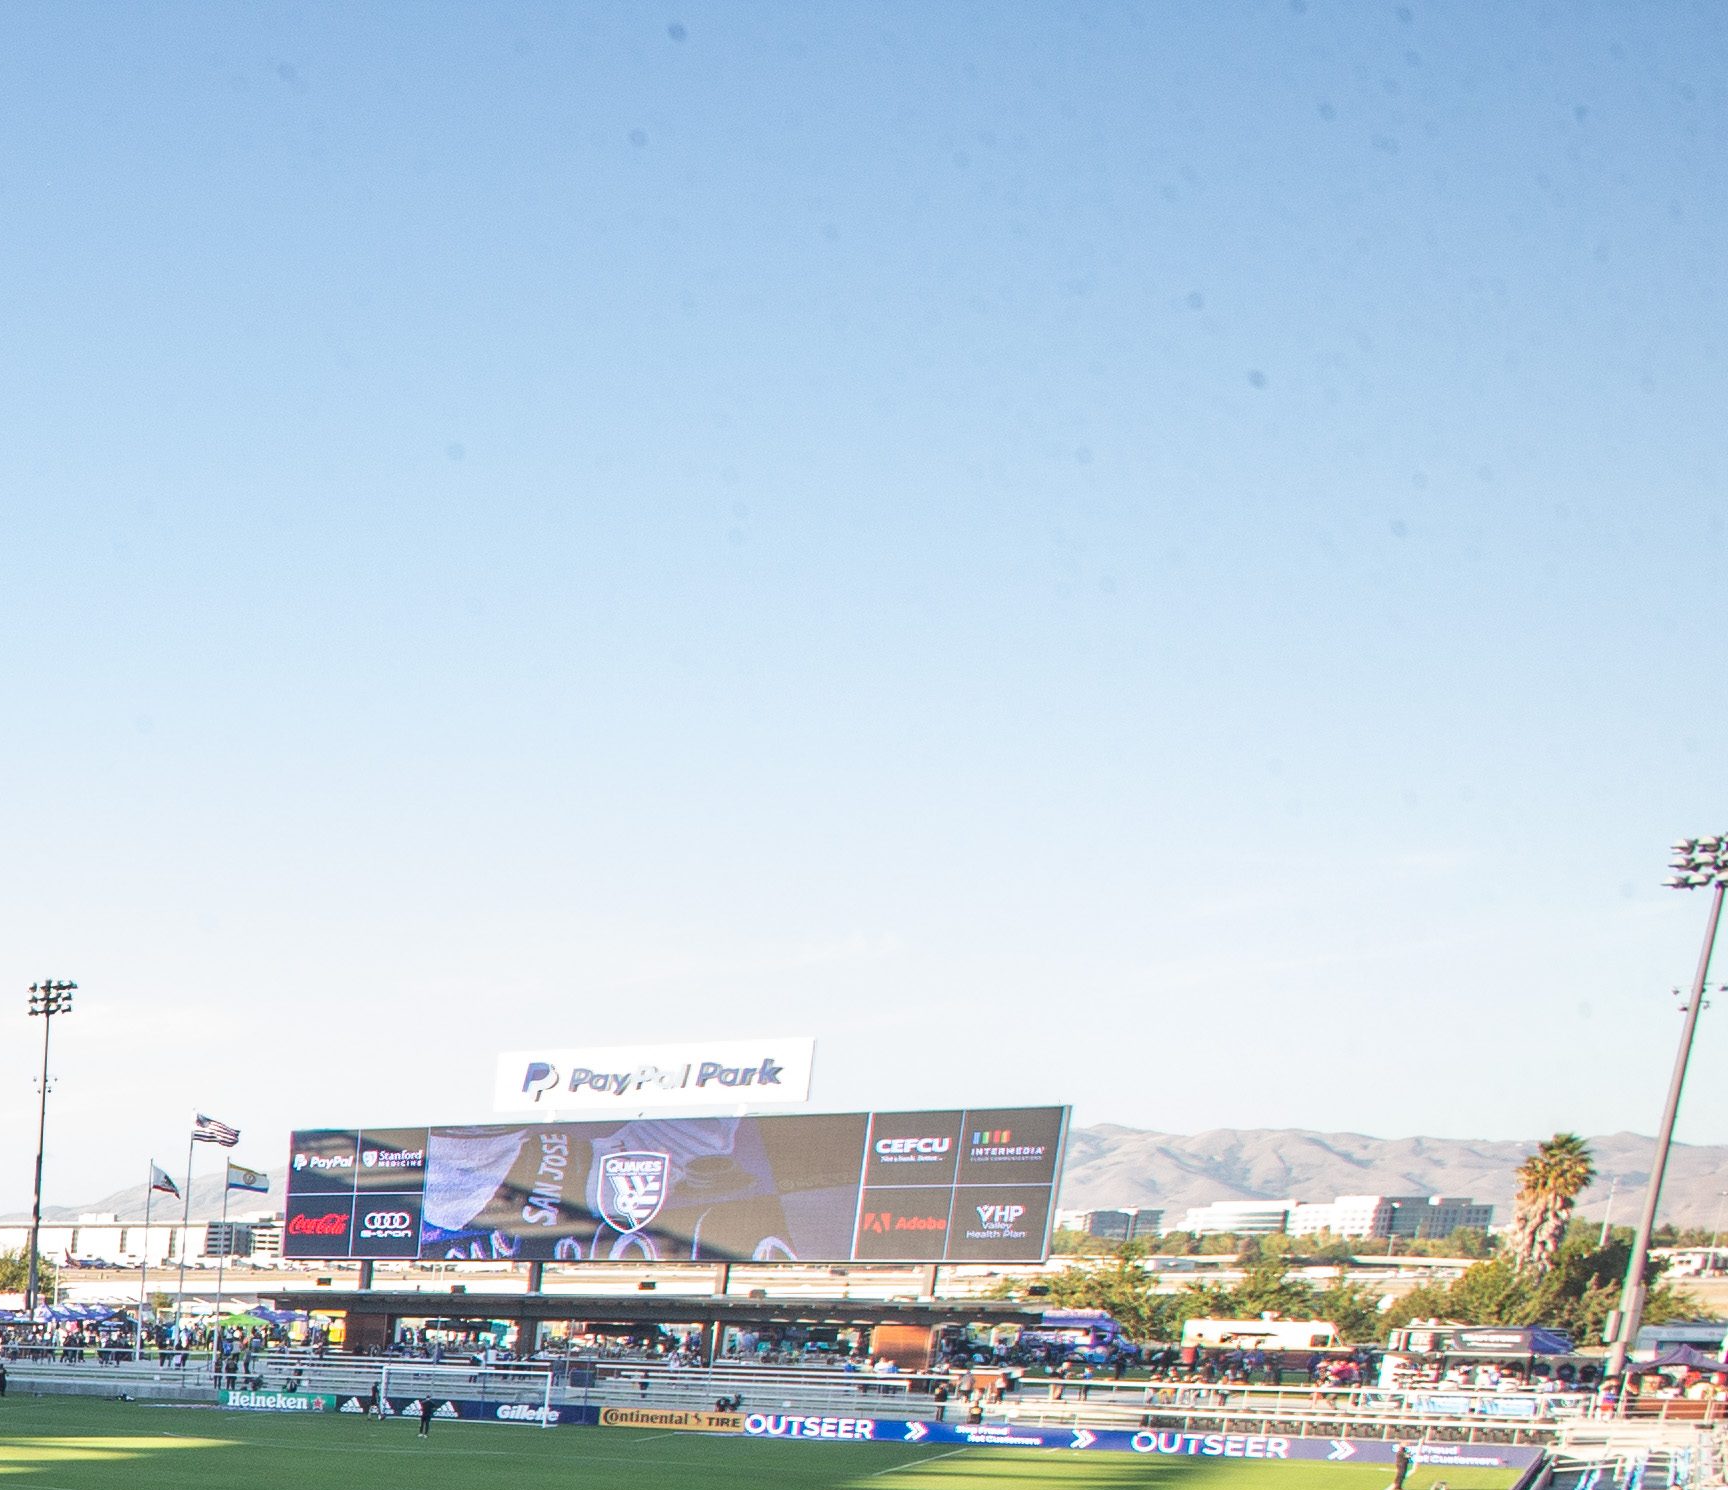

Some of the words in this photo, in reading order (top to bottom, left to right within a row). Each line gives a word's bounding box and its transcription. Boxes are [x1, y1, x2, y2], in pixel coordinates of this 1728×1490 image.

[568, 1063, 692, 1096] PayPal
[695, 1058, 784, 1088] Park
[876, 1137, 952, 1153] CEFCU
[971, 1146, 1042, 1156] INTERMEDIA
[309, 1155, 354, 1169] PayPal
[379, 1150, 423, 1161] Stanford
[541, 1133, 568, 1182] JOSE
[606, 1159, 662, 1174] QUAKES
[522, 1182, 562, 1227] SAN
[976, 1205, 1026, 1223] VHP
[895, 1216, 947, 1231] Adobe
[982, 1221, 1013, 1232] Valley
[966, 1231, 1001, 1239] Health
[1003, 1231, 1027, 1239] Plan
[227, 1391, 307, 1409] Heineken
[603, 1409, 689, 1425] Continental
[707, 1416, 741, 1428] TIRE
[745, 1413, 875, 1439] OUTSEER
[955, 1425, 978, 1434] Stop
[978, 1427, 1010, 1436] Fraud
[967, 1434, 986, 1443] Not
[985, 1436, 1042, 1445] Customers
[1131, 1431, 1291, 1459] OUTSEER
[1430, 1454, 1501, 1465] Customers
